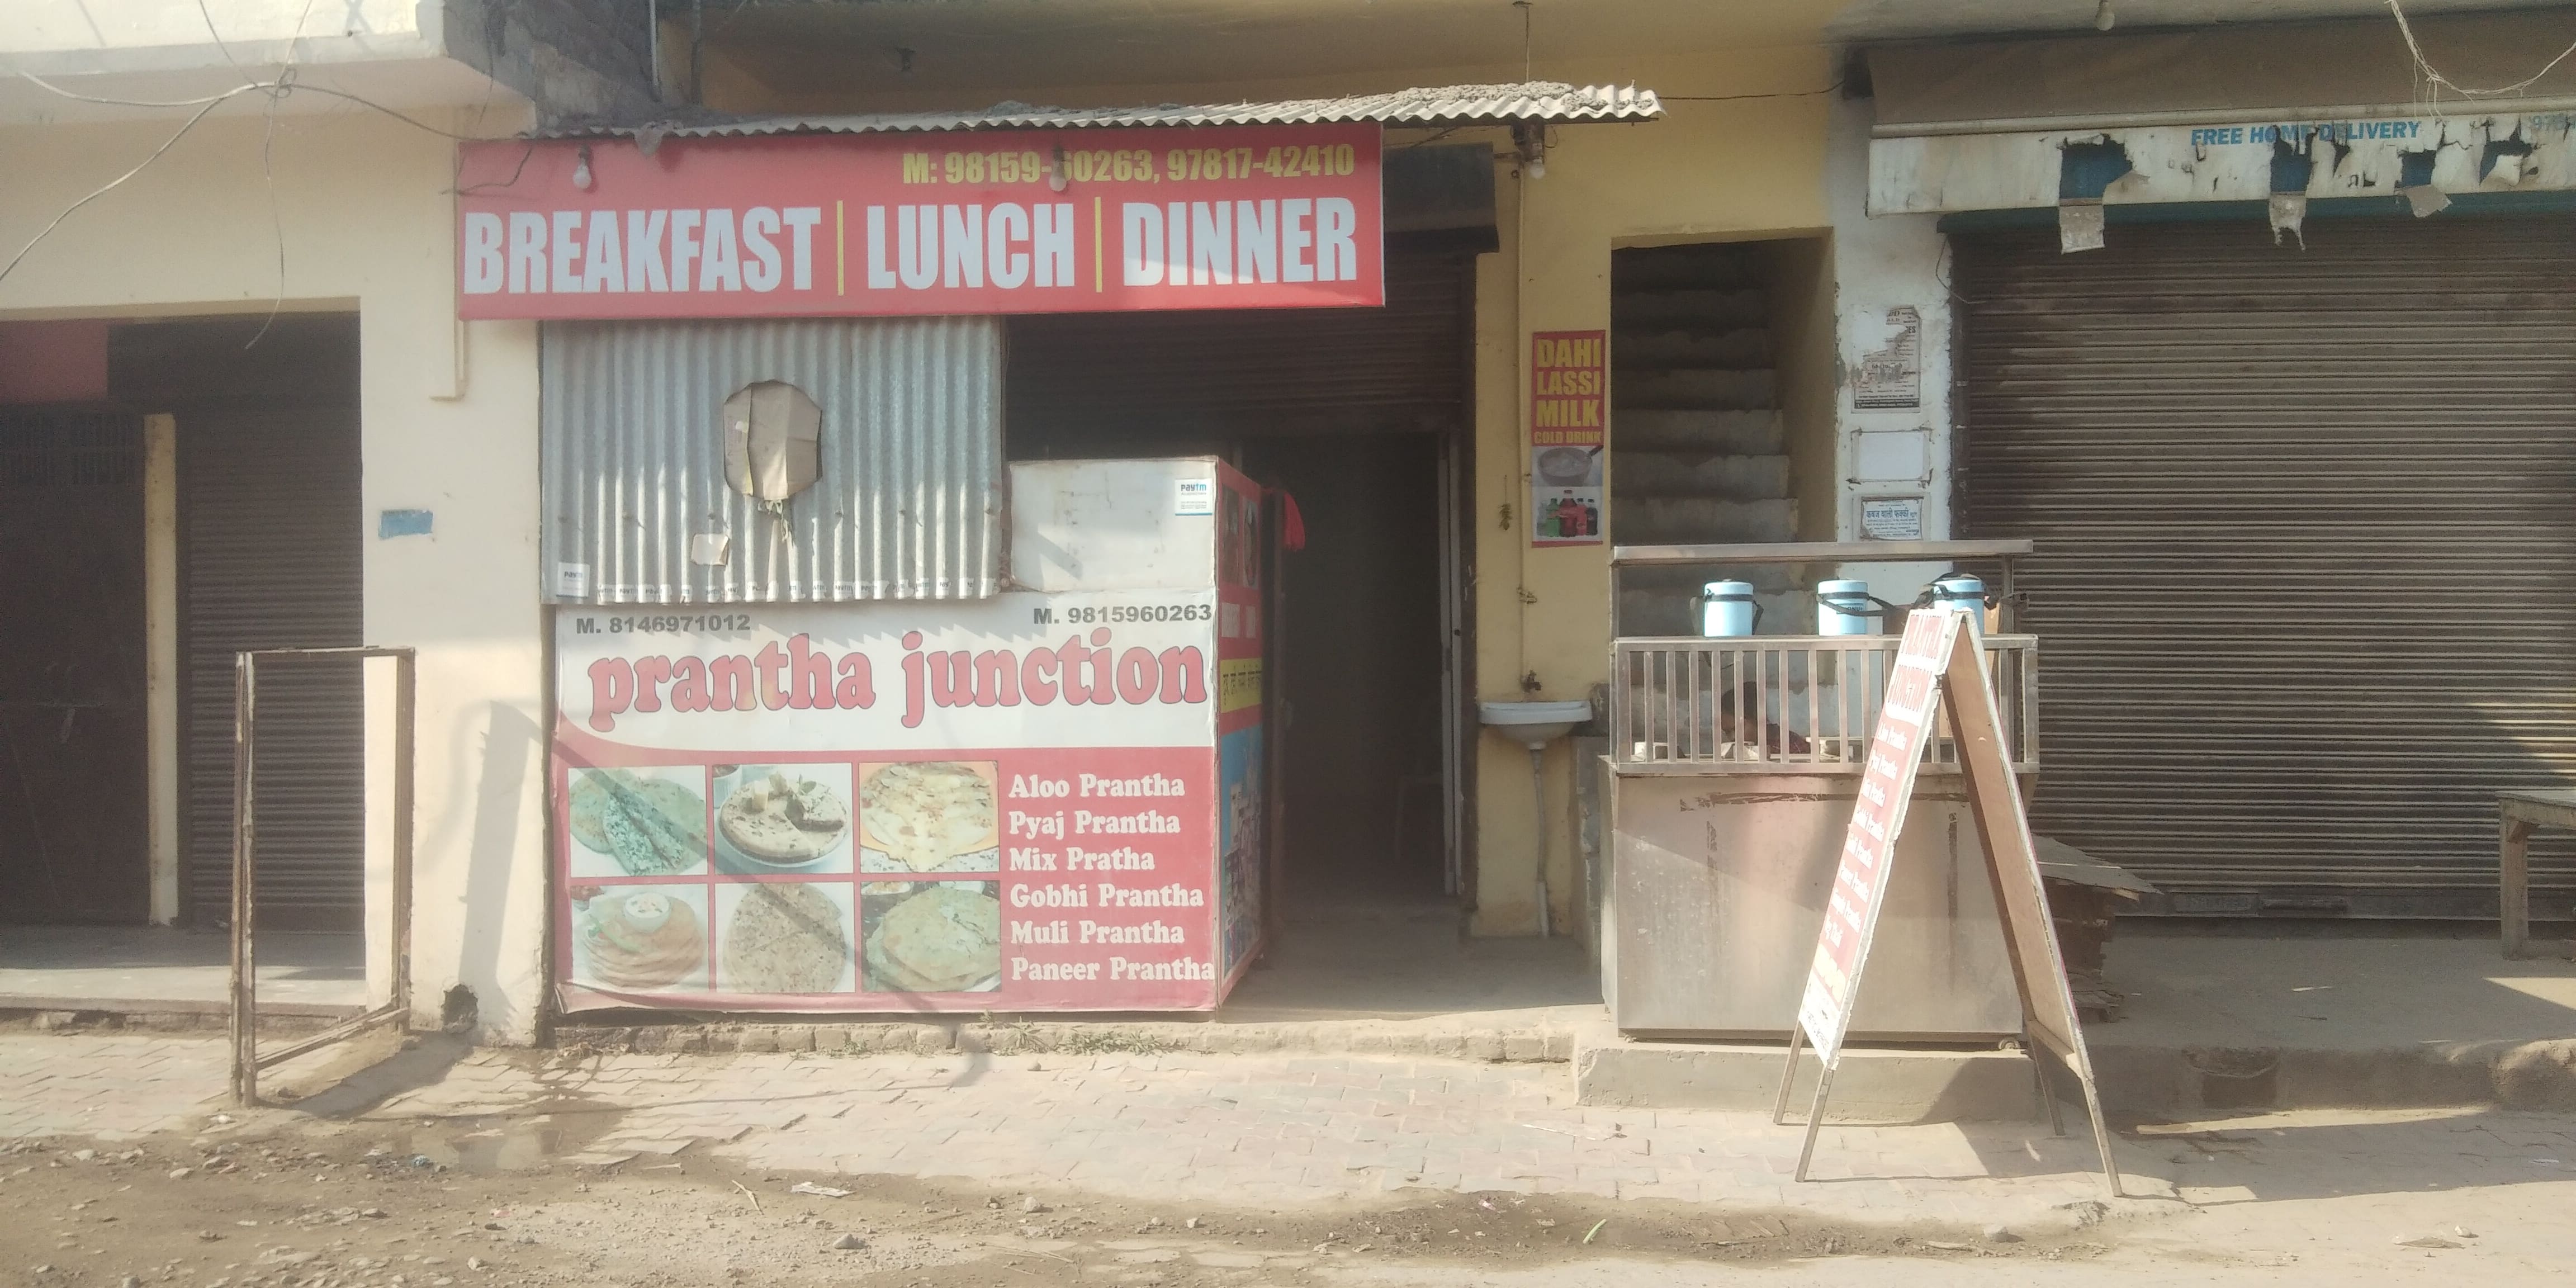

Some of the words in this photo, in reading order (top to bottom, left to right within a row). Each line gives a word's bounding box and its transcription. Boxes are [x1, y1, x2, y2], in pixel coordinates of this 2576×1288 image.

[2191, 127, 2243, 145] FREE
[903, 153, 937, 184] M:
[1167, 144, 1355, 182] 97817-42410
[463, 206, 821, 295] BREAKFAST
[867, 202, 1075, 290] LUNCH
[1123, 197, 1357, 287] DINNER
[1537, 339, 1601, 367] DAHI
[1537, 371, 1600, 395] LASSI
[1536, 400, 1600, 427] MILK
[1535, 432, 1564, 443] COLD
[1566, 431, 1601, 443] DRINK
[576, 617, 602, 634] M.
[609, 614, 751, 633] 8146971012
[1034, 608, 1060, 624] M.
[1068, 604, 1212, 623] 9815960263
[588, 633, 877, 732] prantha
[901, 627, 1208, 728] junction
[1008, 774, 1070, 798] Aloo
[1079, 773, 1185, 797] Prantha
[1008, 811, 1065, 840] Pyaj
[1074, 810, 1181, 834] Prantha
[1009, 847, 1058, 872] Mix
[1066, 846, 1156, 871] Pratha
[1010, 883, 1088, 908] Gobhi
[1098, 883, 1204, 907] Prantha
[1010, 920, 1069, 944] Muli
[1079, 920, 1185, 944] Prantha
[1011, 956, 1101, 981] Paneer
[1110, 956, 1215, 981] Prantha
